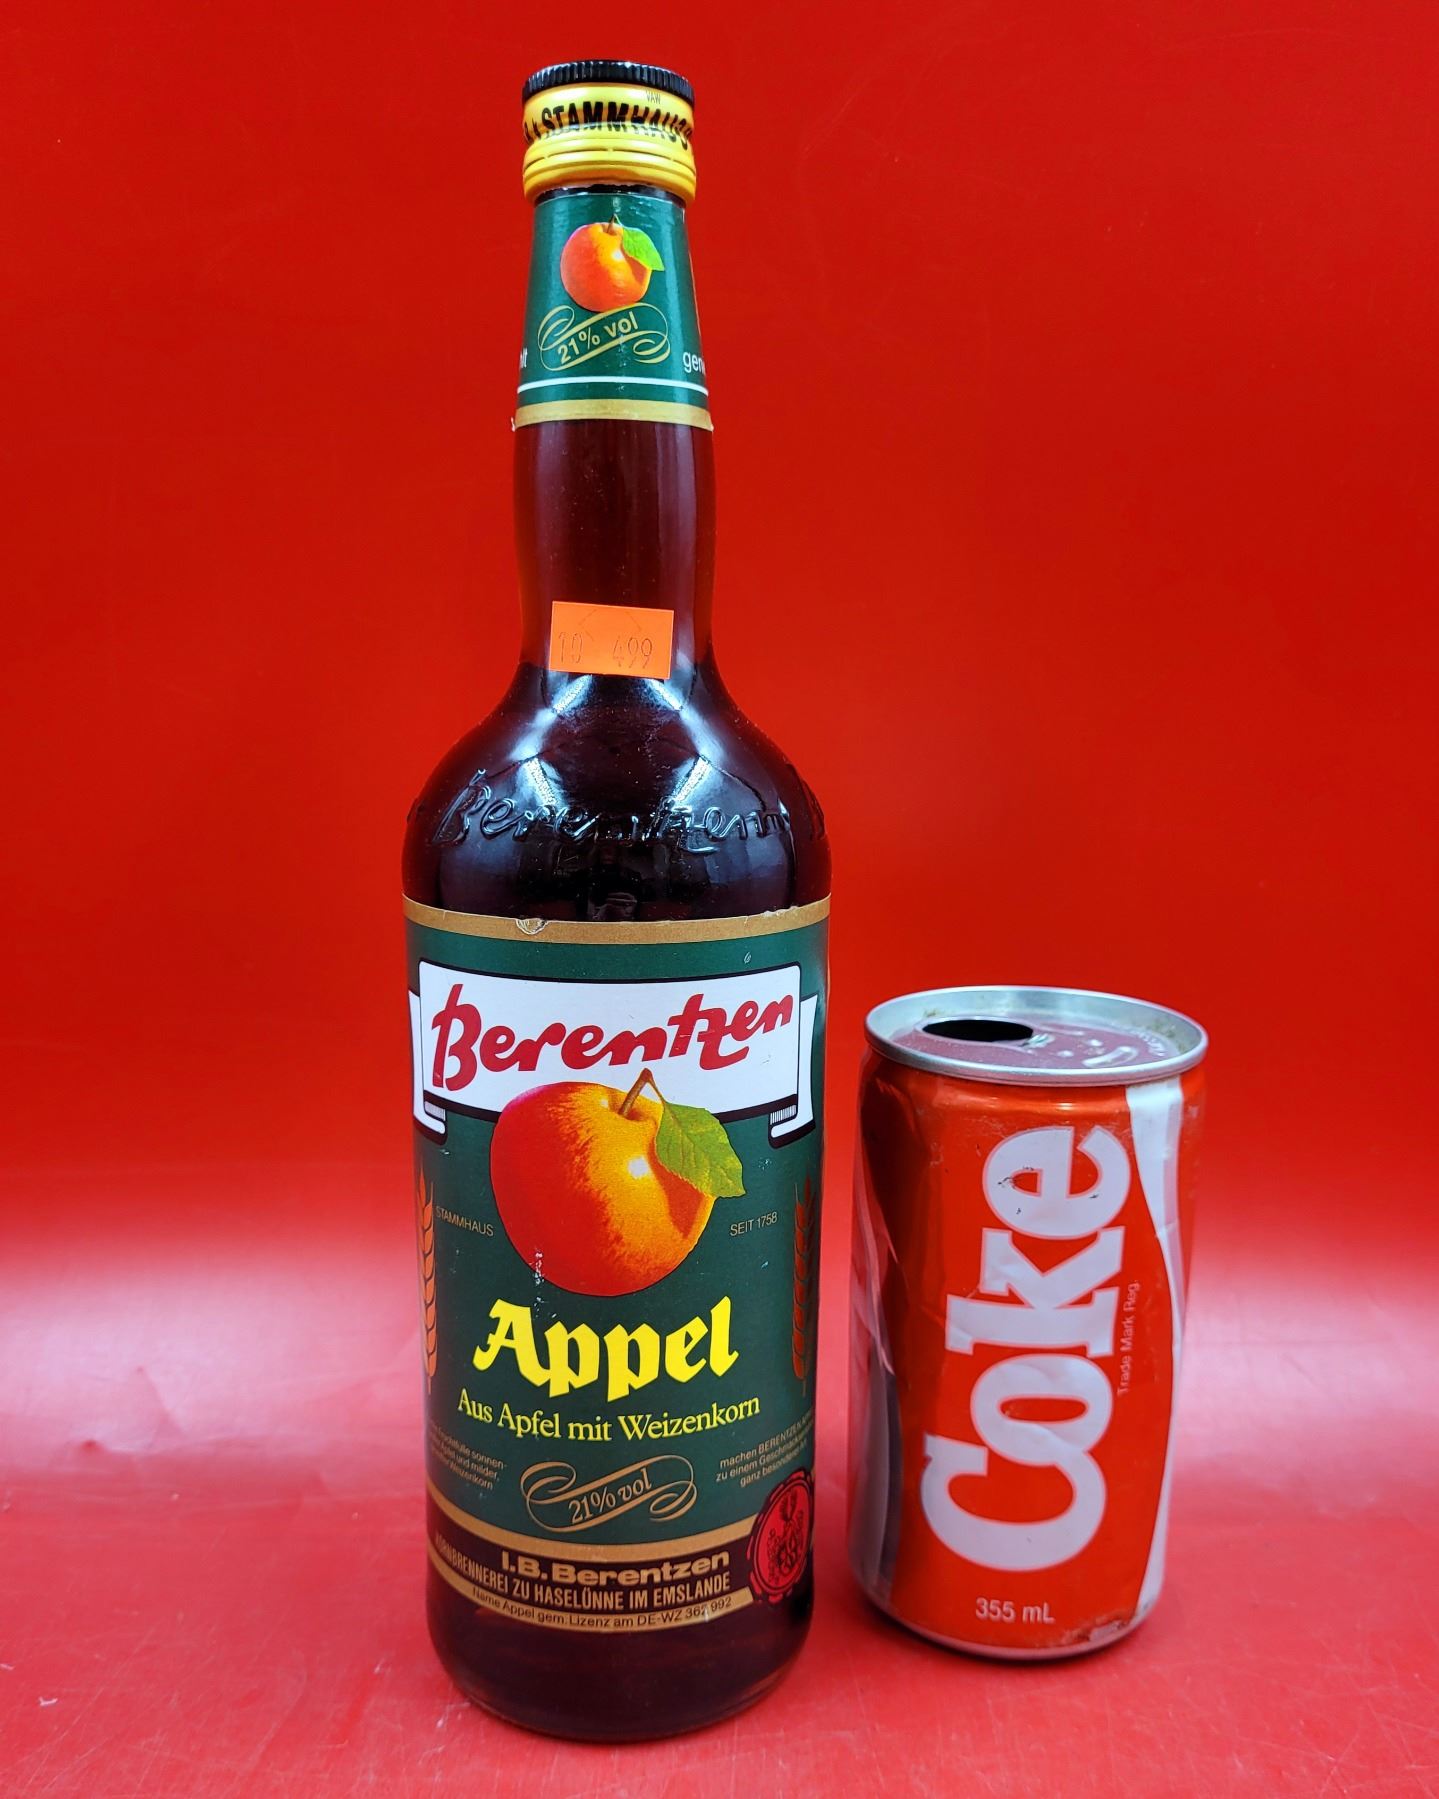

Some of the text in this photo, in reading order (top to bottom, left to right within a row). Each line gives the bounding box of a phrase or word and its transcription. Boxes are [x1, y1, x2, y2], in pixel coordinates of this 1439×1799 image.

[558, 327, 600, 364] 21%
[604, 311, 639, 338] vol
[612, 634, 653, 670] 499
[431, 983, 794, 1092] Berentzen
[435, 1205, 494, 1238] STAMMHAUS
[730, 1211, 778, 1237] SEIT 1758
[472, 1296, 740, 1403] Appel
[919, 1124, 1132, 1572] Coke
[1116, 1279, 1141, 1397] Trade Mark Reg.
[457, 1387, 492, 1424] Aus
[497, 1403, 562, 1439] Apfel
[567, 1415, 613, 1442] mit
[616, 1396, 761, 1442] Weizenkorn
[719, 1448, 757, 1470] machen
[758, 1421, 802, 1455] BERENTZEN
[716, 1471, 728, 1482] zu
[729, 1459, 758, 1478] einem
[740, 1470, 761, 1488] ganz
[568, 1467, 652, 1525] 21% vol
[472, 1587, 501, 1608] Name
[502, 1600, 535, 1618] Appel
[613, 1618, 634, 1628] am
[637, 1609, 683, 1627] DE-WZ
[710, 1596, 732, 1612] 992
[512, 1578, 530, 1600] ZU
[533, 1583, 625, 1612] HASELÜNNE
[629, 1589, 649, 1611] IM
[653, 1571, 731, 1608] EMSLANDE
[975, 1596, 1056, 1624] 355 mL
